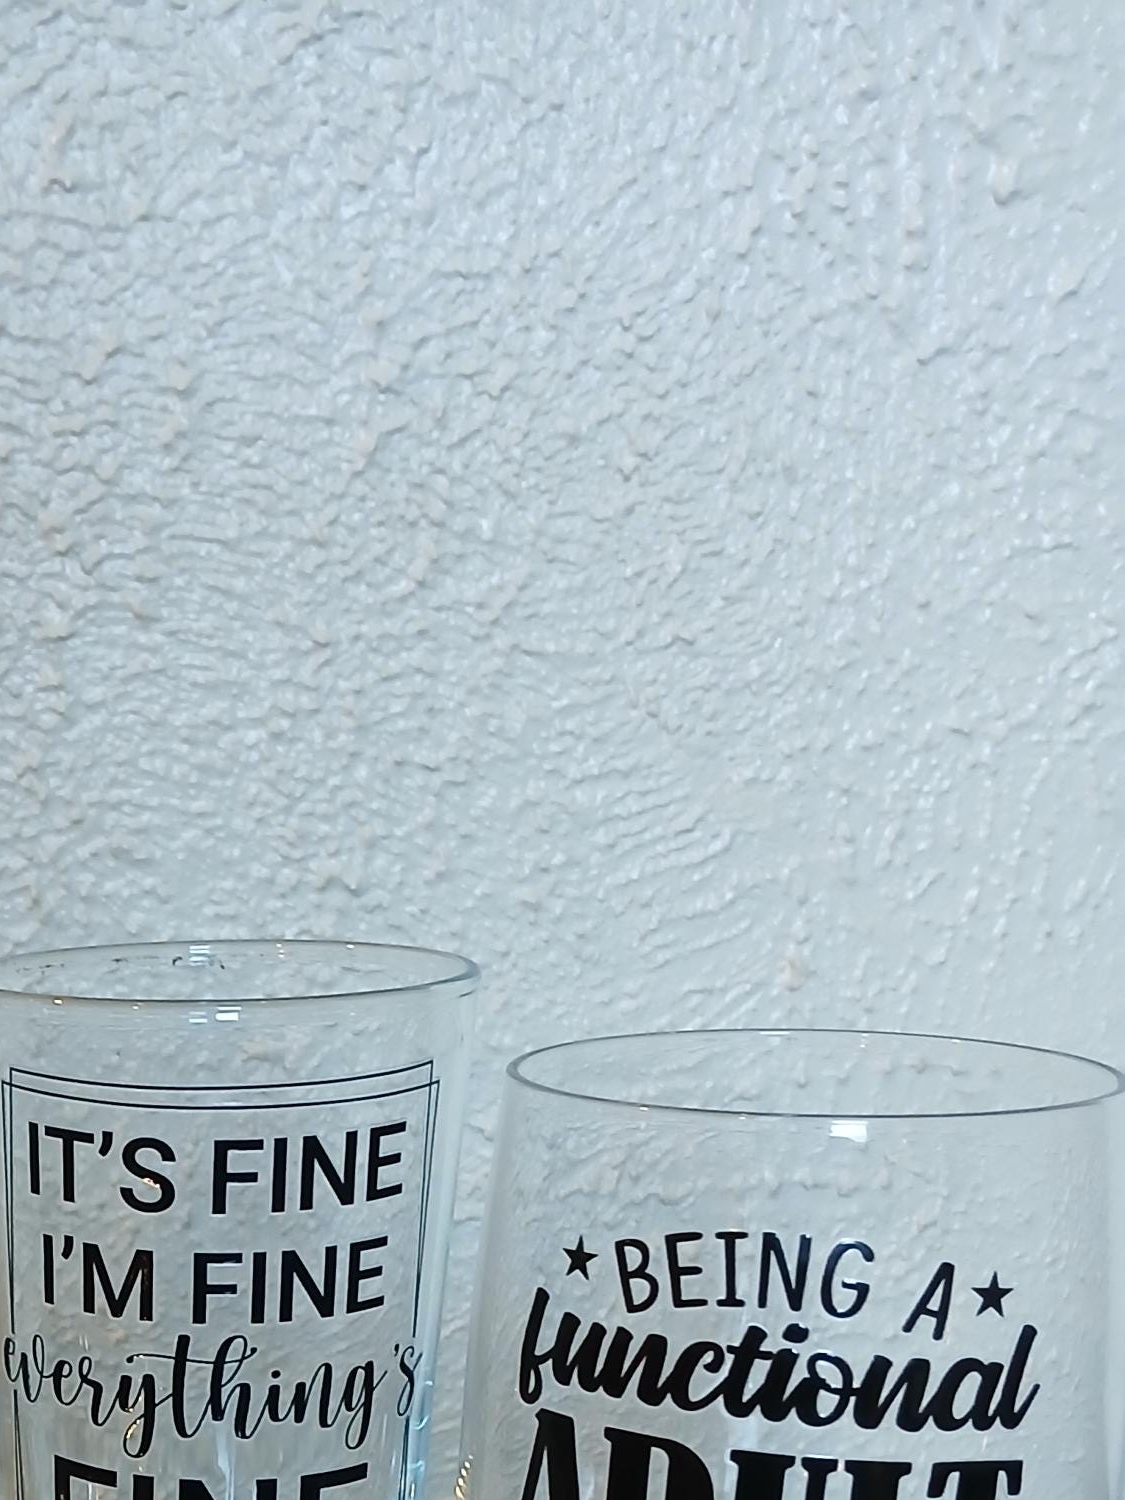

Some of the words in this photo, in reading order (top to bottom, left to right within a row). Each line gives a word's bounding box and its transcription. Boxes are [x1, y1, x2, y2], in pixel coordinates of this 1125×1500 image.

[28, 1121, 177, 1214] IT'S
[211, 1121, 408, 1215] FINE
[42, 1233, 155, 1323] I'M
[191, 1236, 390, 1325] FINE
[614, 1231, 875, 1319] BEING
[902, 1261, 955, 1341] A
[3, 1333, 423, 1458] everything's
[518, 1287, 1041, 1433] functional
